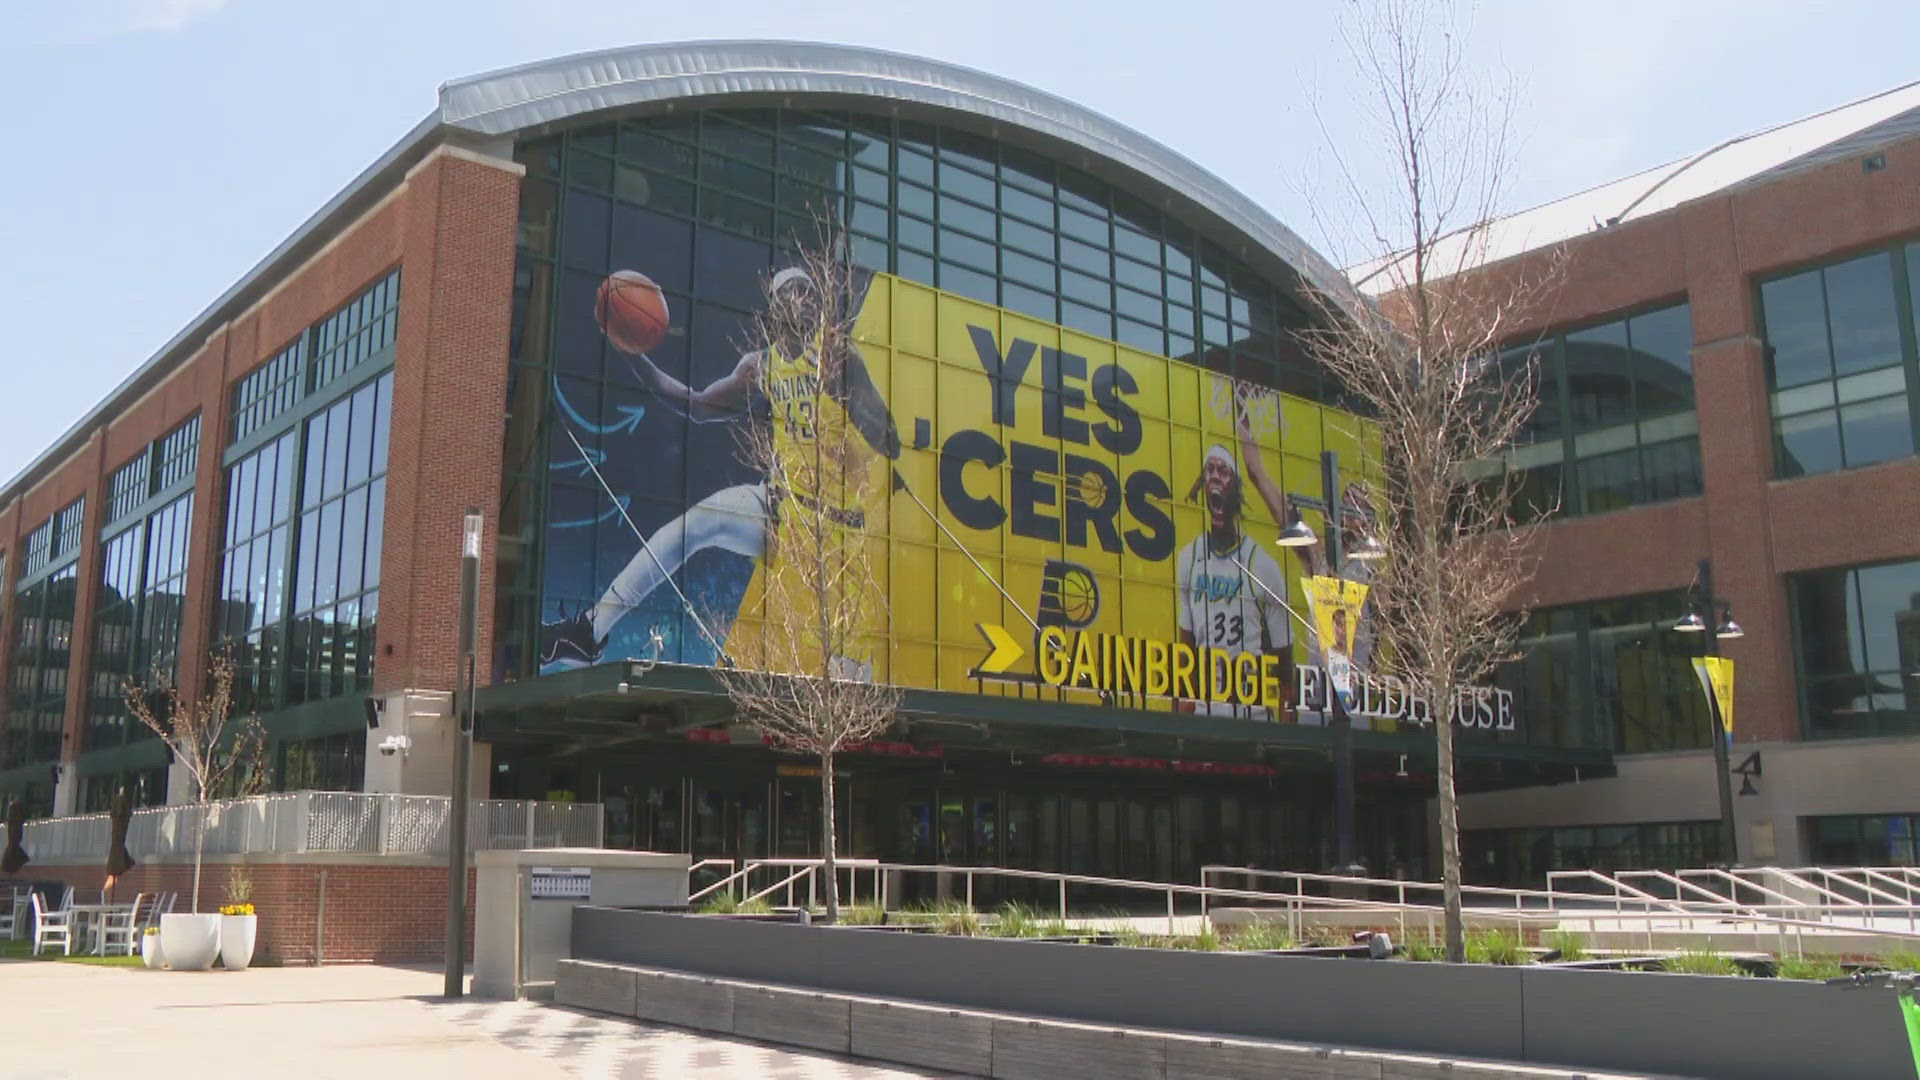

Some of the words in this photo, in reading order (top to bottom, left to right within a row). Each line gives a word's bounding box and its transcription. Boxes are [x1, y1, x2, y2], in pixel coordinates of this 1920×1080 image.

[966, 323, 1143, 456] YES
[1039, 624, 1280, 708] GAINBRIDGE
[1296, 663, 1515, 731] FILDHUSE
[1214, 611, 1243, 647] 33
